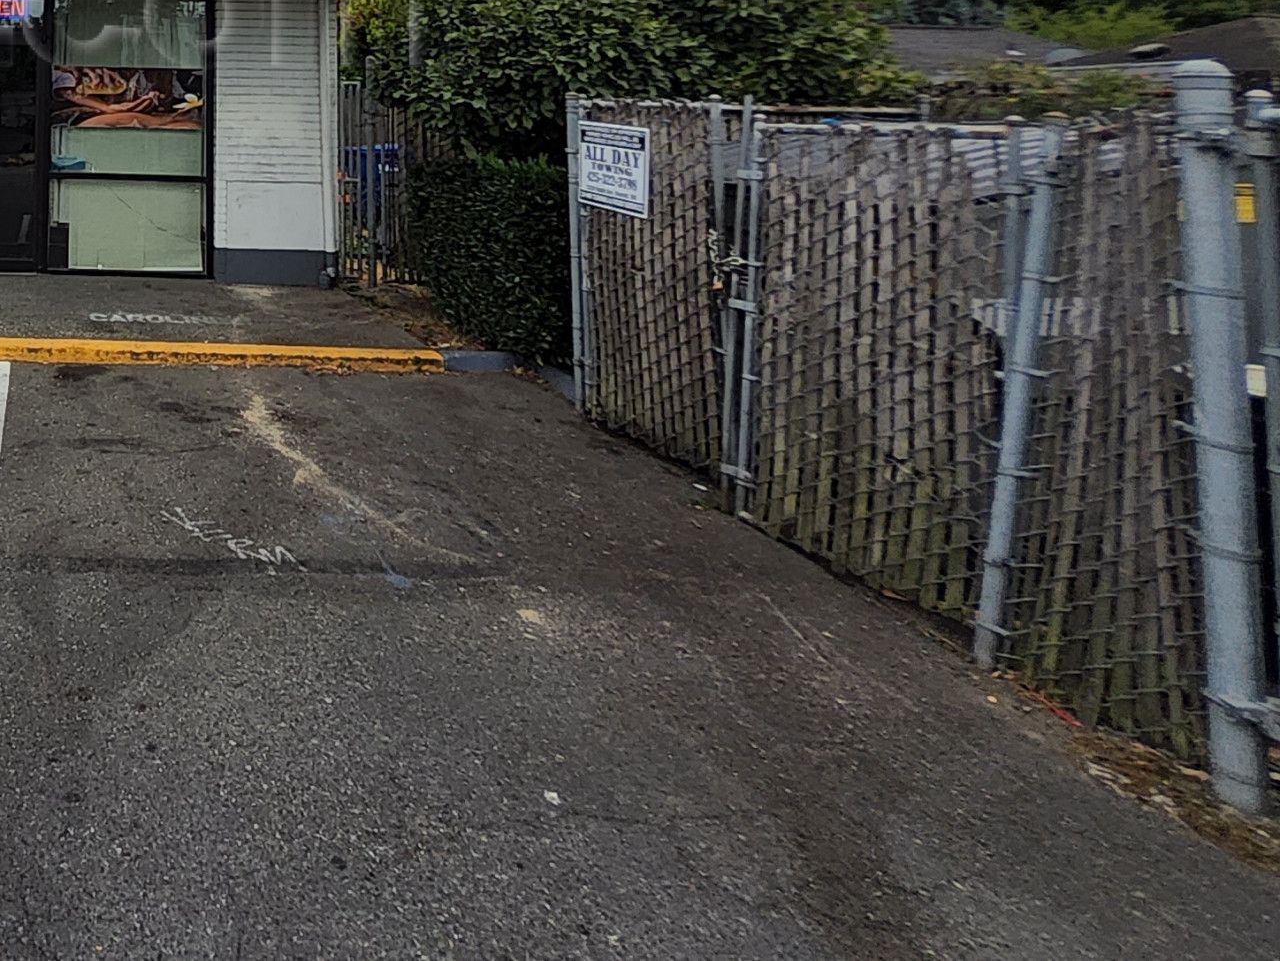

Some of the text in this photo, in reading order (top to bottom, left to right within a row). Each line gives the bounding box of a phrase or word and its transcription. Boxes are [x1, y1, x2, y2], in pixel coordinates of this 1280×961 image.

[585, 145, 641, 168] ALL DAY
[591, 162, 632, 176] TOWING
